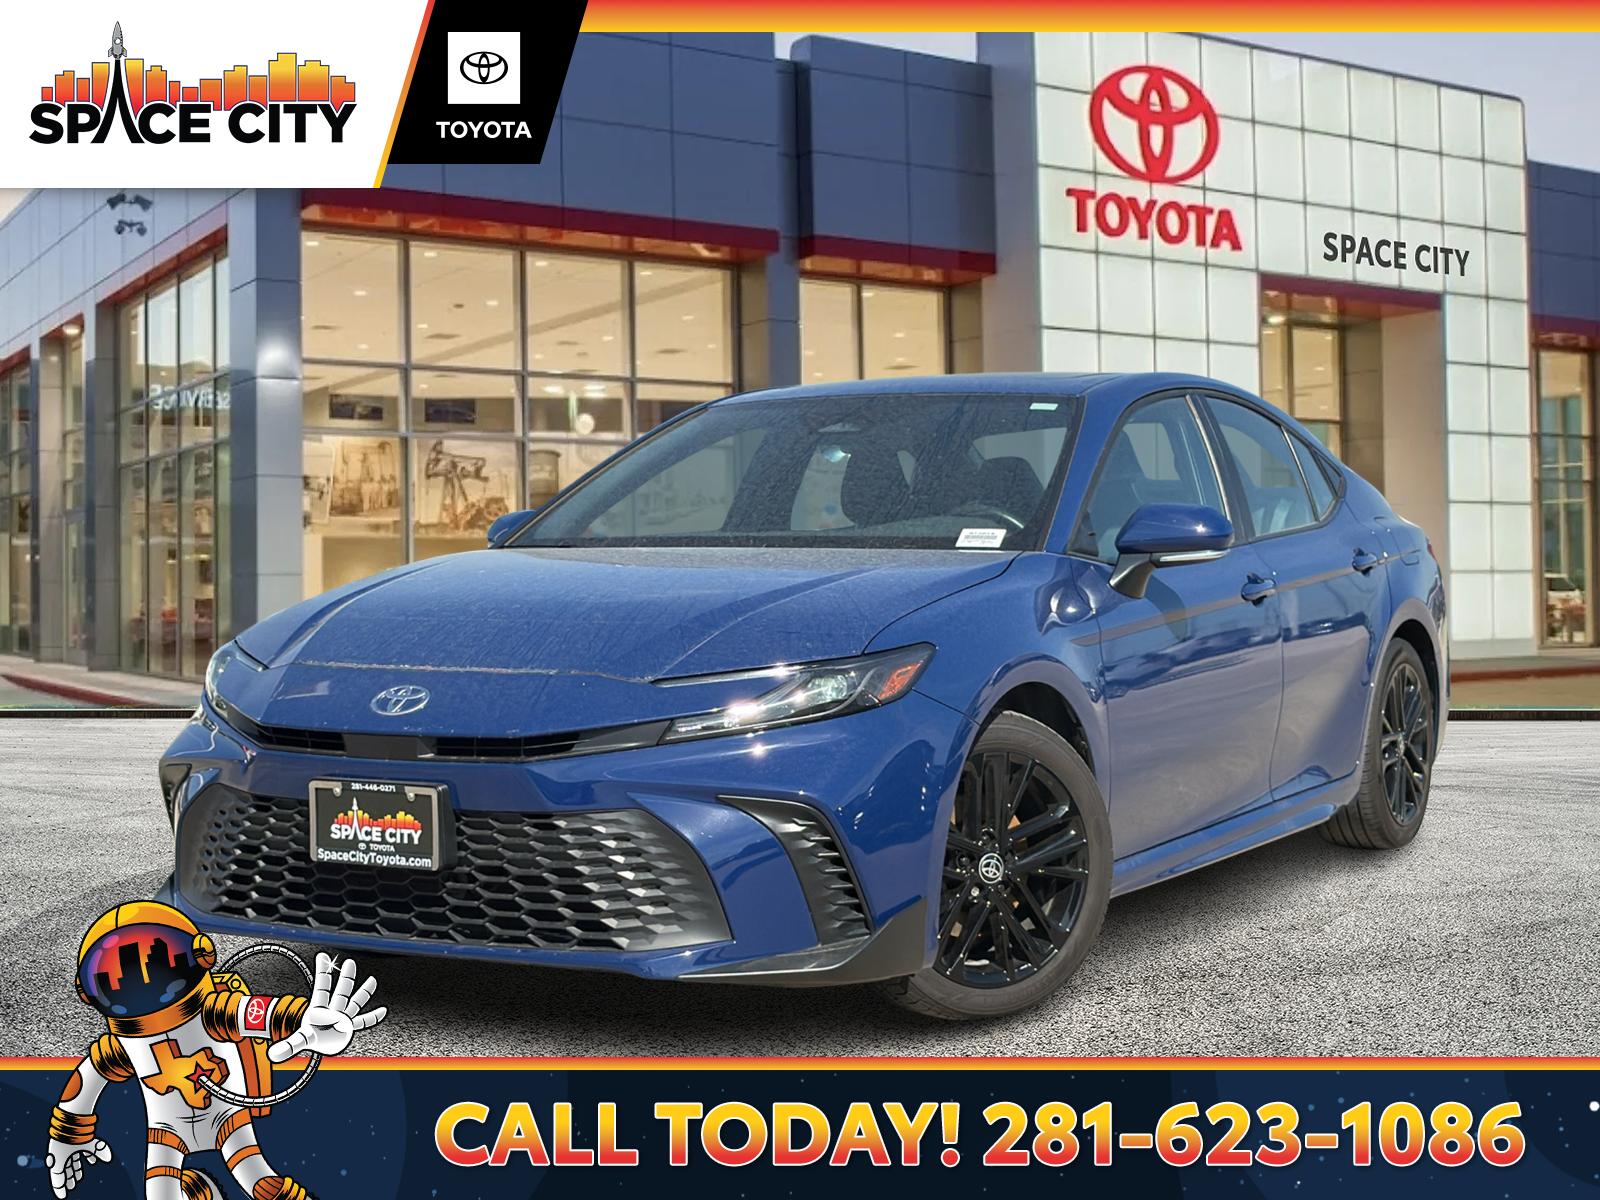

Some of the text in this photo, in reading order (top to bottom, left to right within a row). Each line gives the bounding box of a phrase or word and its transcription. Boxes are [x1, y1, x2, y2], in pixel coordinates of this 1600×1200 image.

[1066, 187, 1242, 251] TOYOTA
[1323, 232, 1470, 276] SPACE CITY
[351, 782, 396, 793] 281-446-0271
[330, 821, 422, 844] SPACE CITY
[317, 848, 432, 867] SpaceCityToyota.com
[369, 843, 395, 852] TOYOTA
